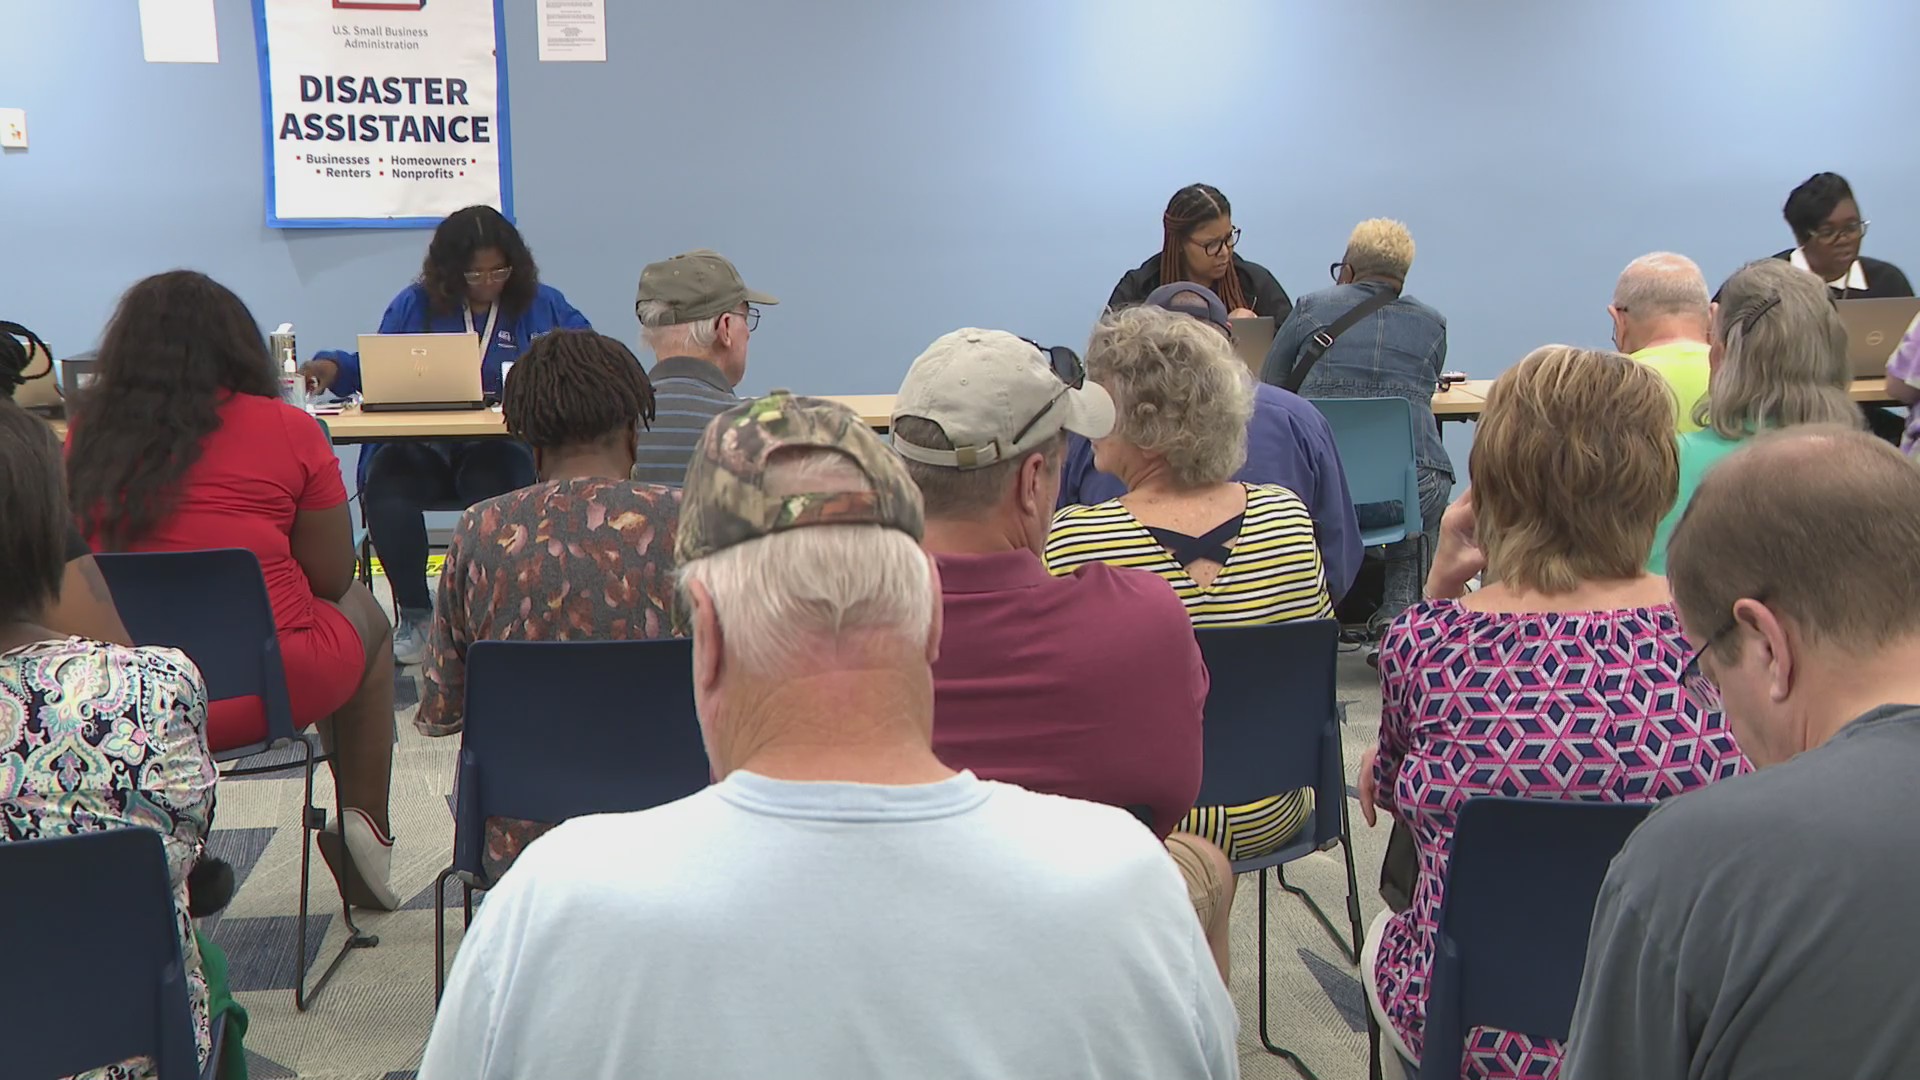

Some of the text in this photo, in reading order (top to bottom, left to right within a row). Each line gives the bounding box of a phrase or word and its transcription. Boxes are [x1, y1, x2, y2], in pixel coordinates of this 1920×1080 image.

[332, 25, 428, 38] U.S. Small Business
[344, 39, 419, 50] Administration
[299, 75, 469, 105] DISASTER
[279, 113, 490, 143] ASSISTANCE
[306, 154, 467, 167] Businesses Homeowners
[326, 168, 454, 180] Renters Nonprofits
